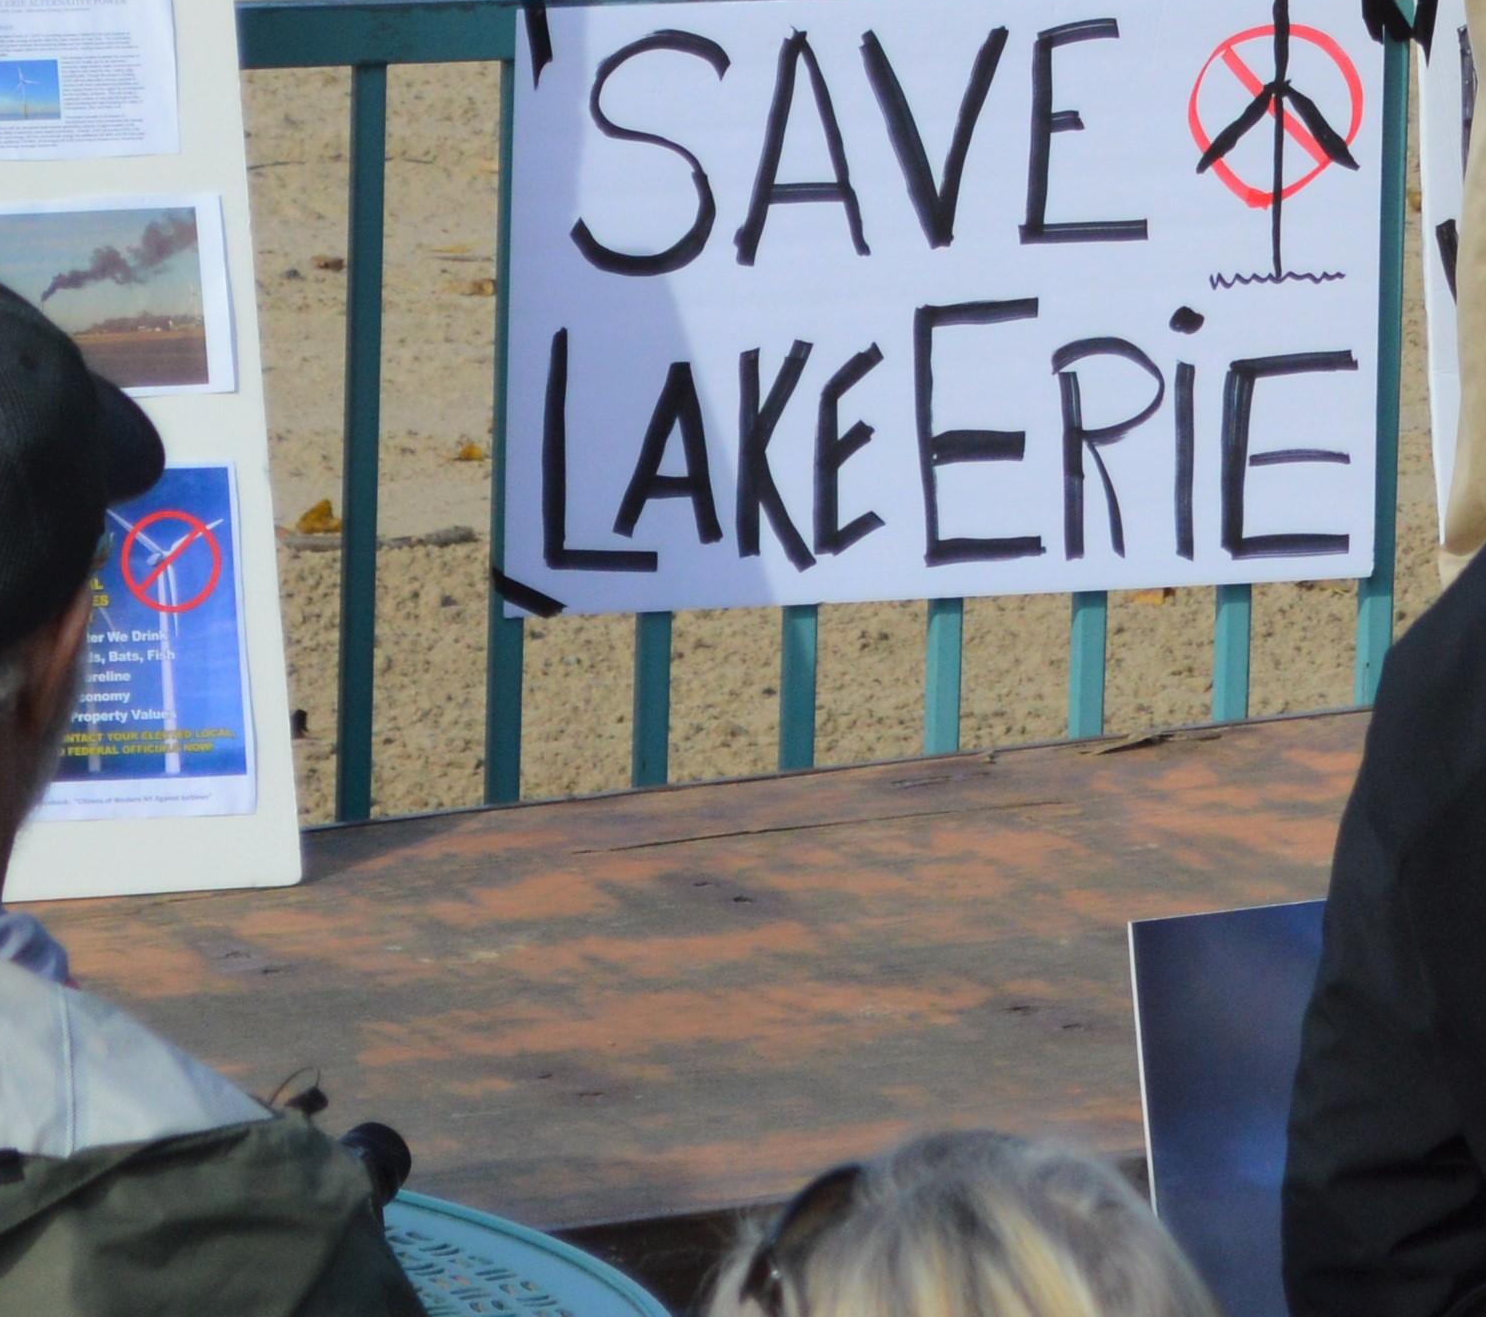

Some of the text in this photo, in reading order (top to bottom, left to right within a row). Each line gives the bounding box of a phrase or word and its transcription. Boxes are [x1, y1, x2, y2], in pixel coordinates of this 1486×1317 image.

[569, 18, 1149, 275] SAVE
[542, 327, 885, 570] LAKE
[107, 631, 128, 643] We
[131, 629, 167, 642] Drink
[108, 650, 144, 664] Bats,
[147, 649, 176, 661] Fish
[80, 692, 130, 704] conomy
[130, 708, 177, 721] Values
[68, 745, 119, 756] FEDERAL
